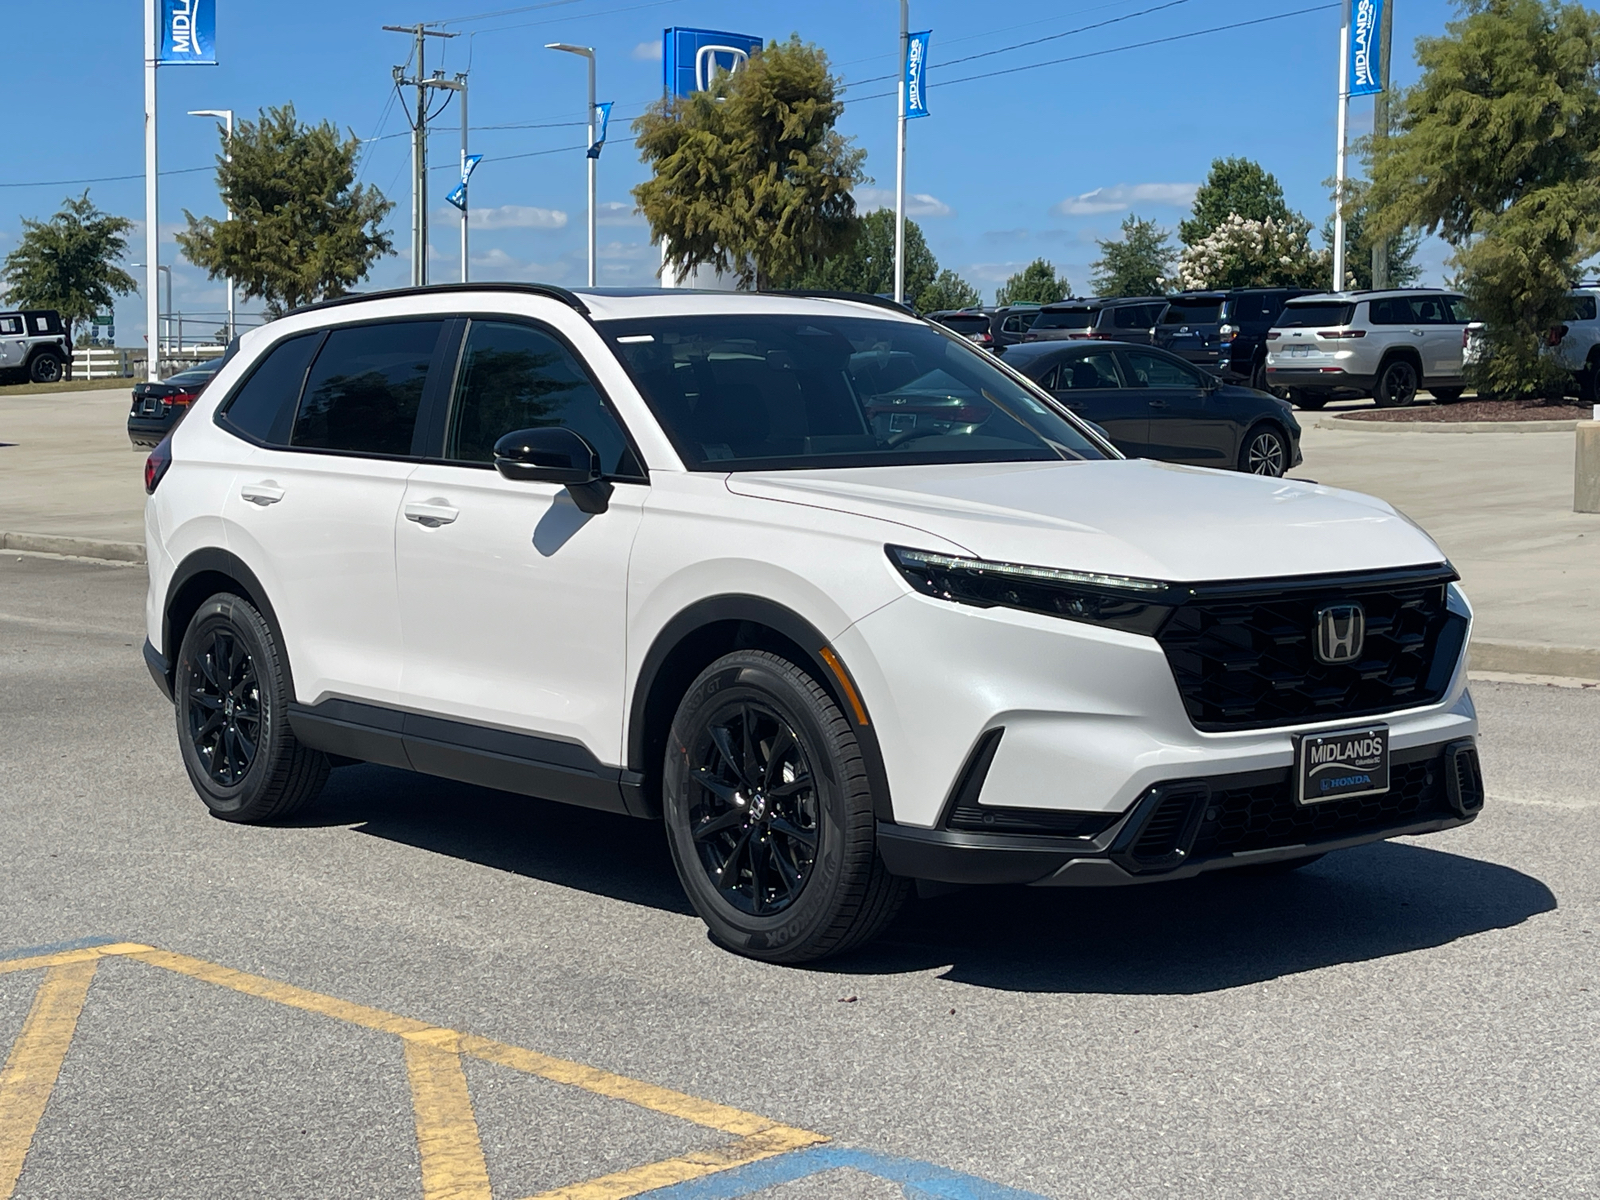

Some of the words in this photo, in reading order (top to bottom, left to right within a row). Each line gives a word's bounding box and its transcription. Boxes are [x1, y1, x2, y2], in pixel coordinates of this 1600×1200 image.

[1355, 0, 1370, 85] MIDLANDS
[909, 38, 919, 110] MIDLANDS
[707, 677, 722, 694] GT
[1311, 738, 1382, 764] MIDLANDS
[1331, 775, 1371, 788] HONDA
